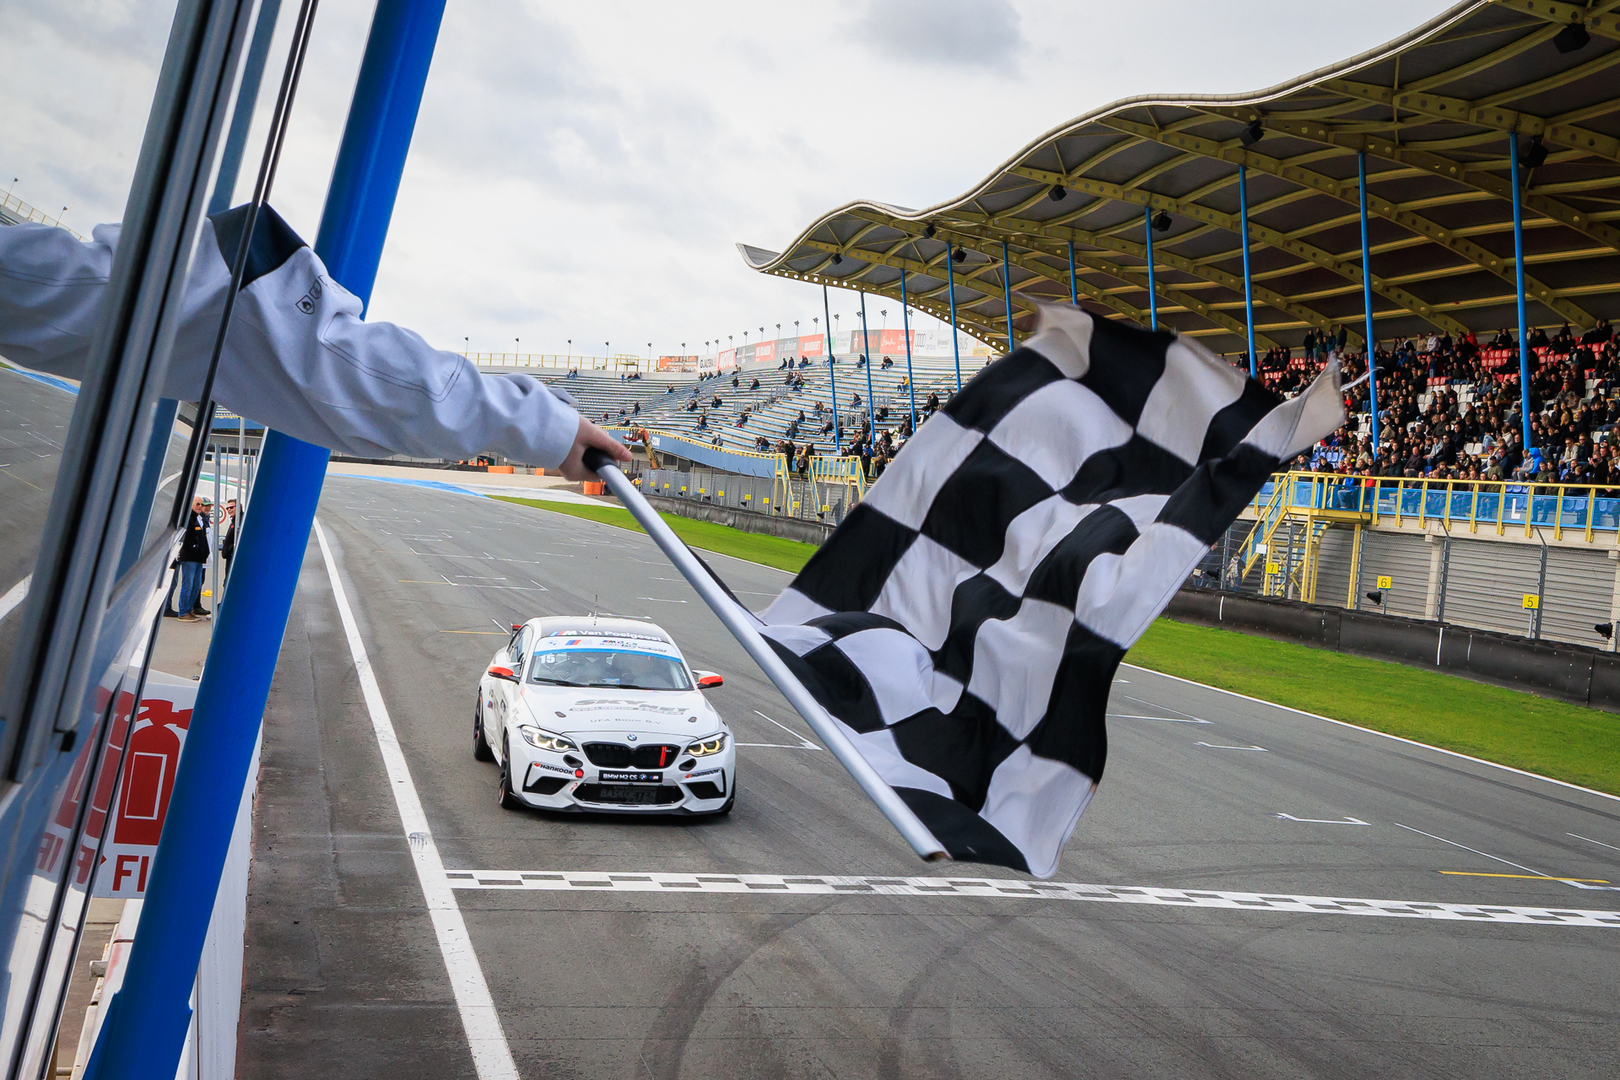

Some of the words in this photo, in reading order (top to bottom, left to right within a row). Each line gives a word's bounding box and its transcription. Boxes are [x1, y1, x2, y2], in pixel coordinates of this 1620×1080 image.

[1511, 498, 1521, 520] L
[1269, 564, 1276, 574] 7
[1379, 577, 1388, 588] 6
[1526, 596, 1535, 608] 5
[539, 654, 556, 664] 15
